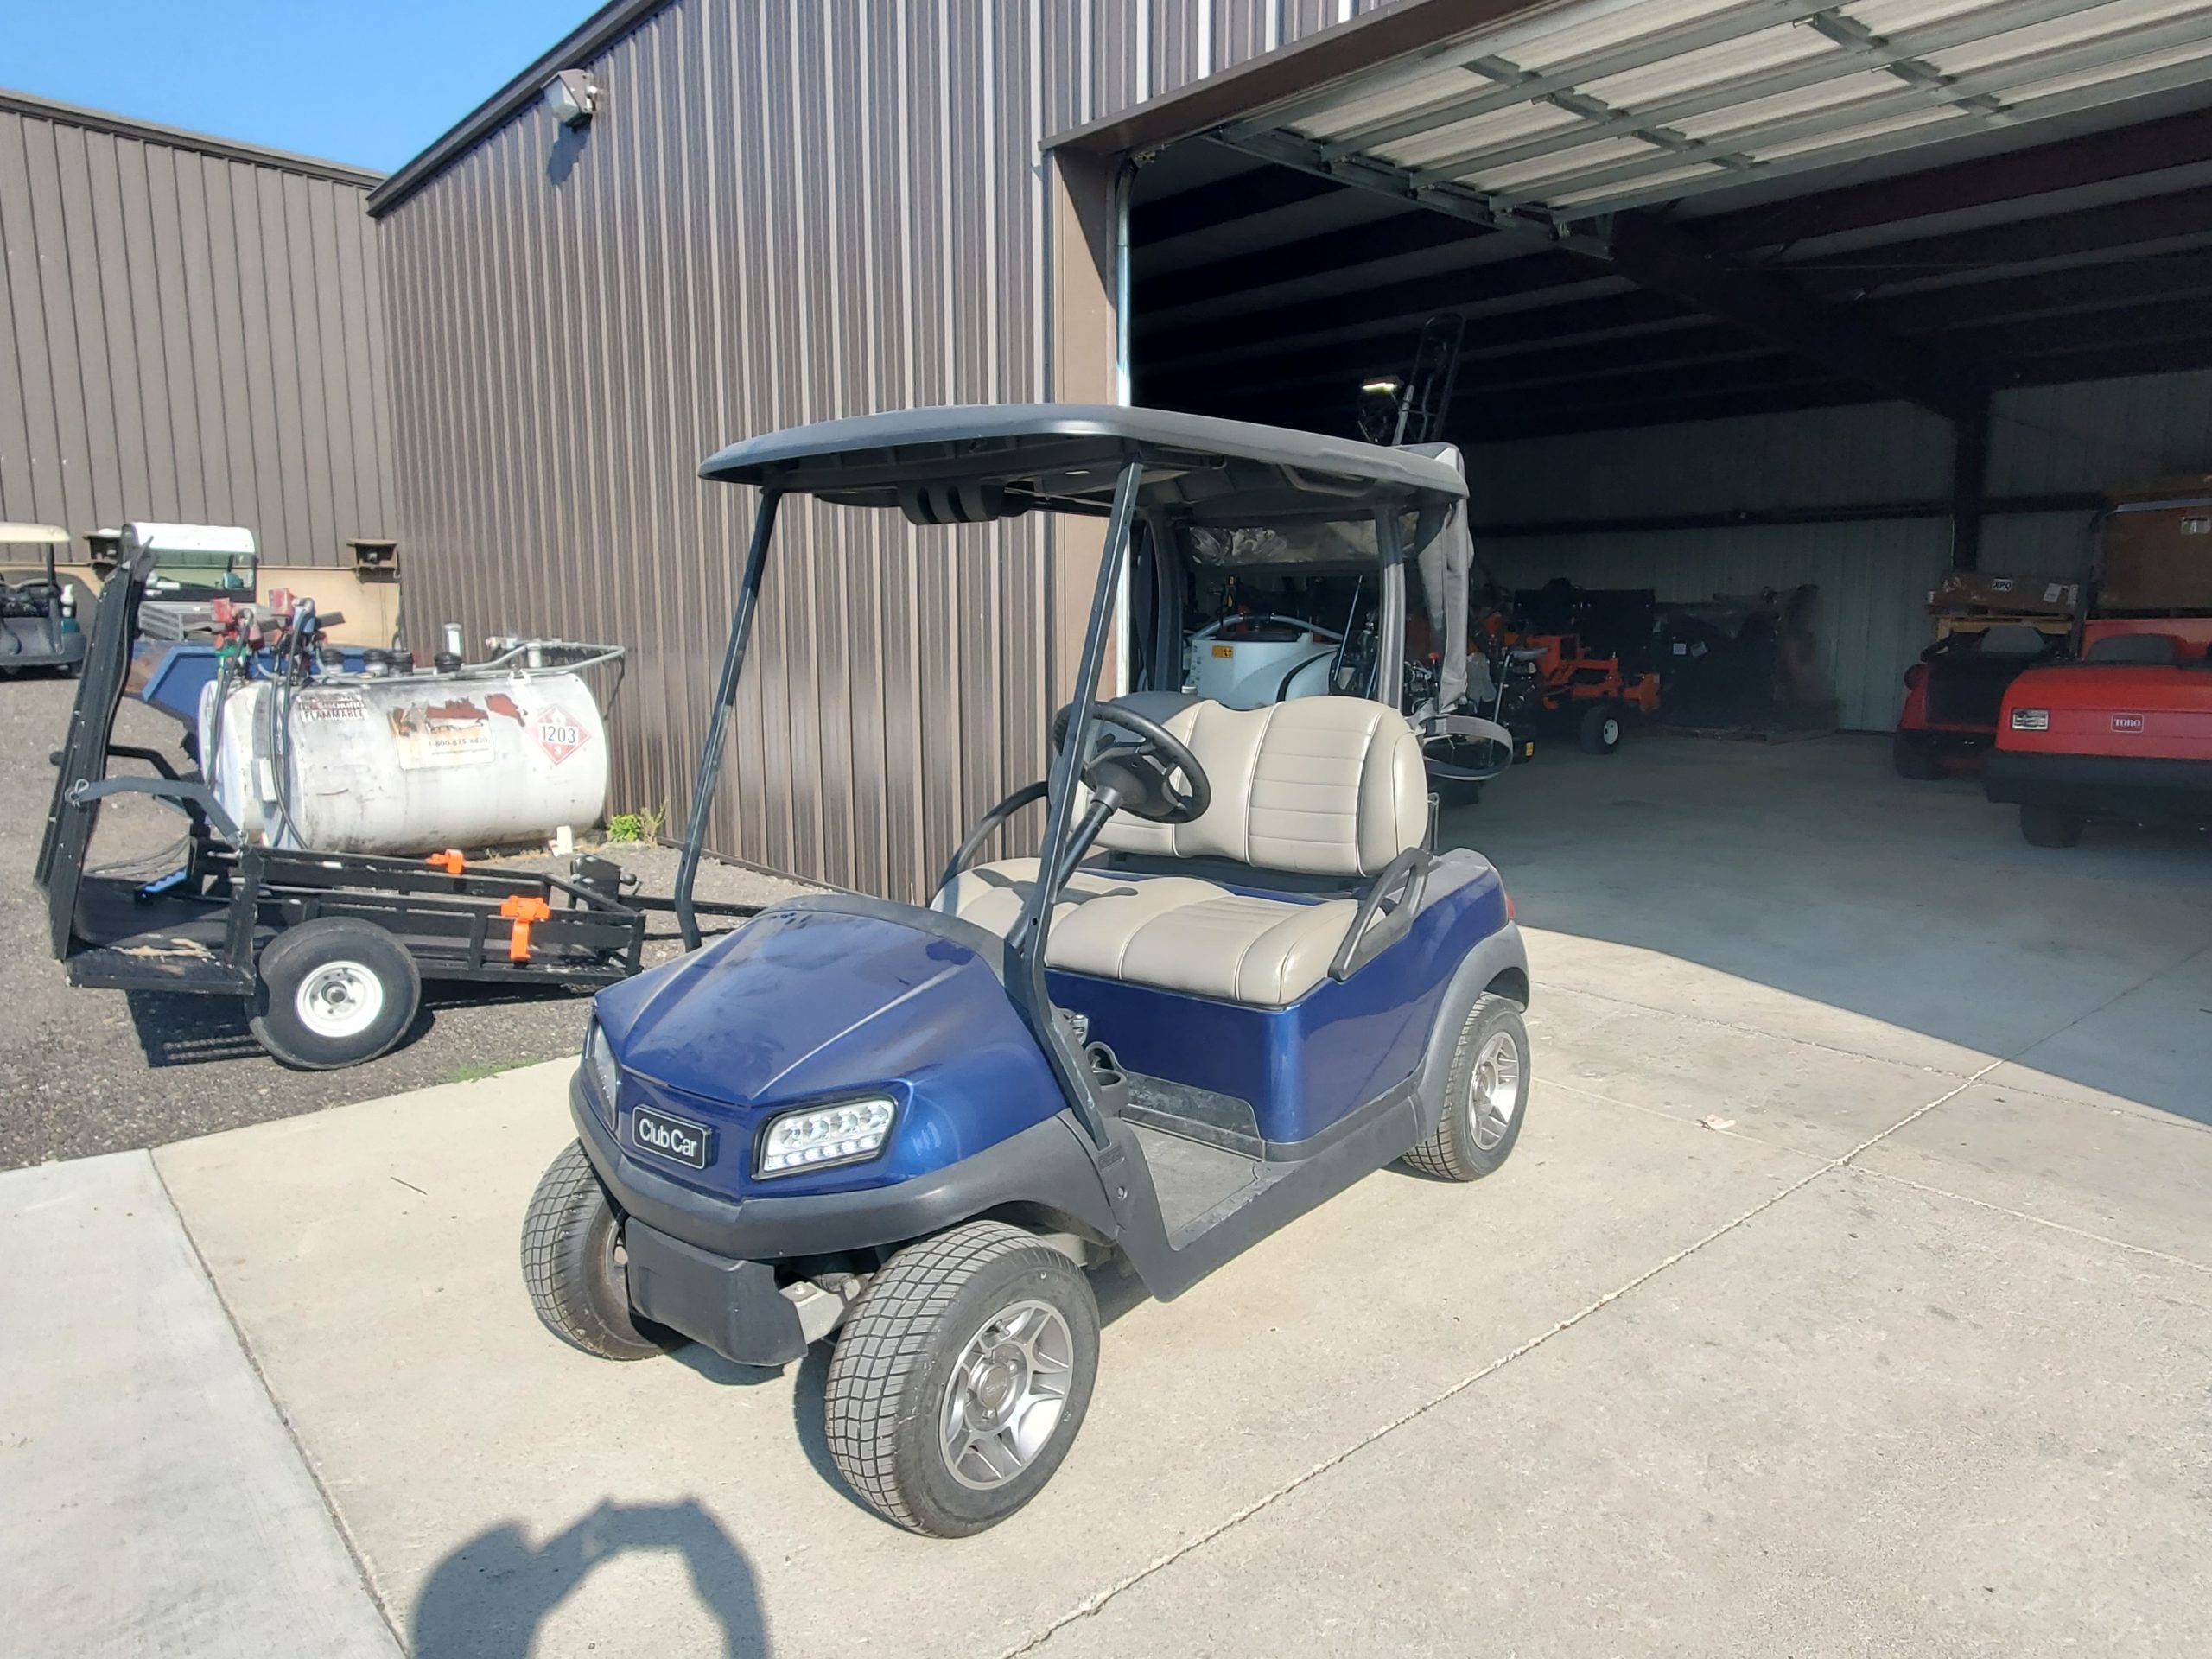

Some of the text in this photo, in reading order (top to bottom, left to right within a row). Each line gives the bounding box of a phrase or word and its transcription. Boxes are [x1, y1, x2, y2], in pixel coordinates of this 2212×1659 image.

[1993, 581, 2012, 591] XPO
[2113, 718, 2141, 727] TORO
[542, 726, 575, 743] 1203
[554, 746, 562, 756] 3
[639, 1118, 698, 1157] Club Car
